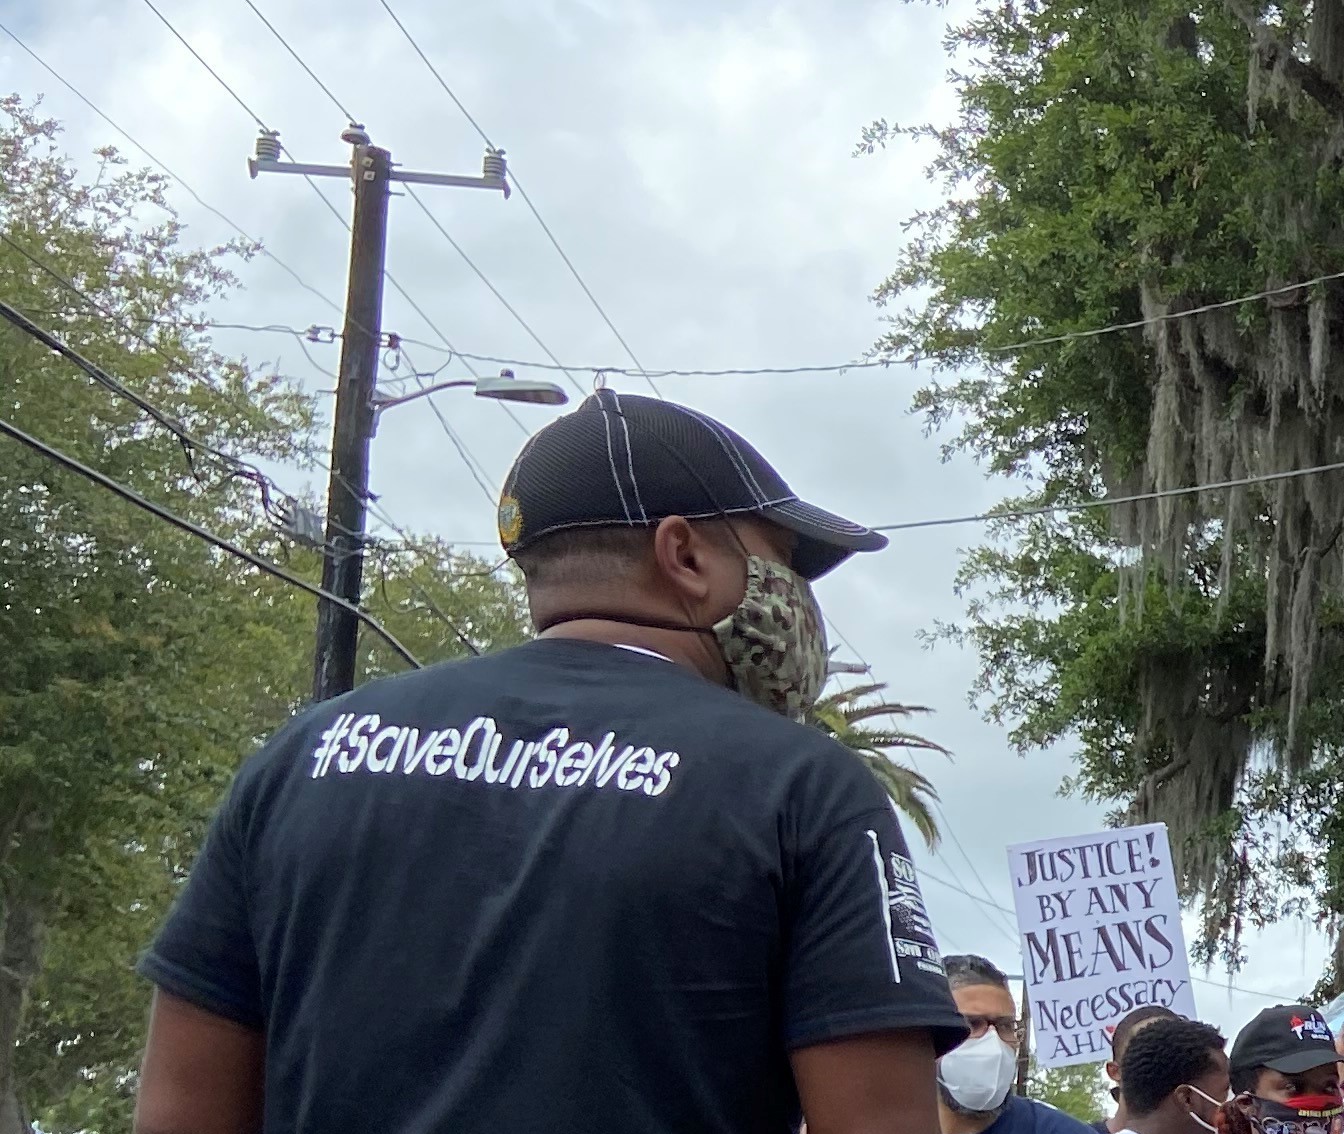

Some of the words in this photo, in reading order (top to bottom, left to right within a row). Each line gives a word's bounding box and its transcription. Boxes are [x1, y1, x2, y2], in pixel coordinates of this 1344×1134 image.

[311, 712, 681, 797] #SaveOurSelves
[1017, 831, 1161, 888] JUSTICE!
[1036, 889, 1077, 924] BY
[1085, 877, 1163, 917] ANY
[1023, 914, 1175, 987] MEANS
